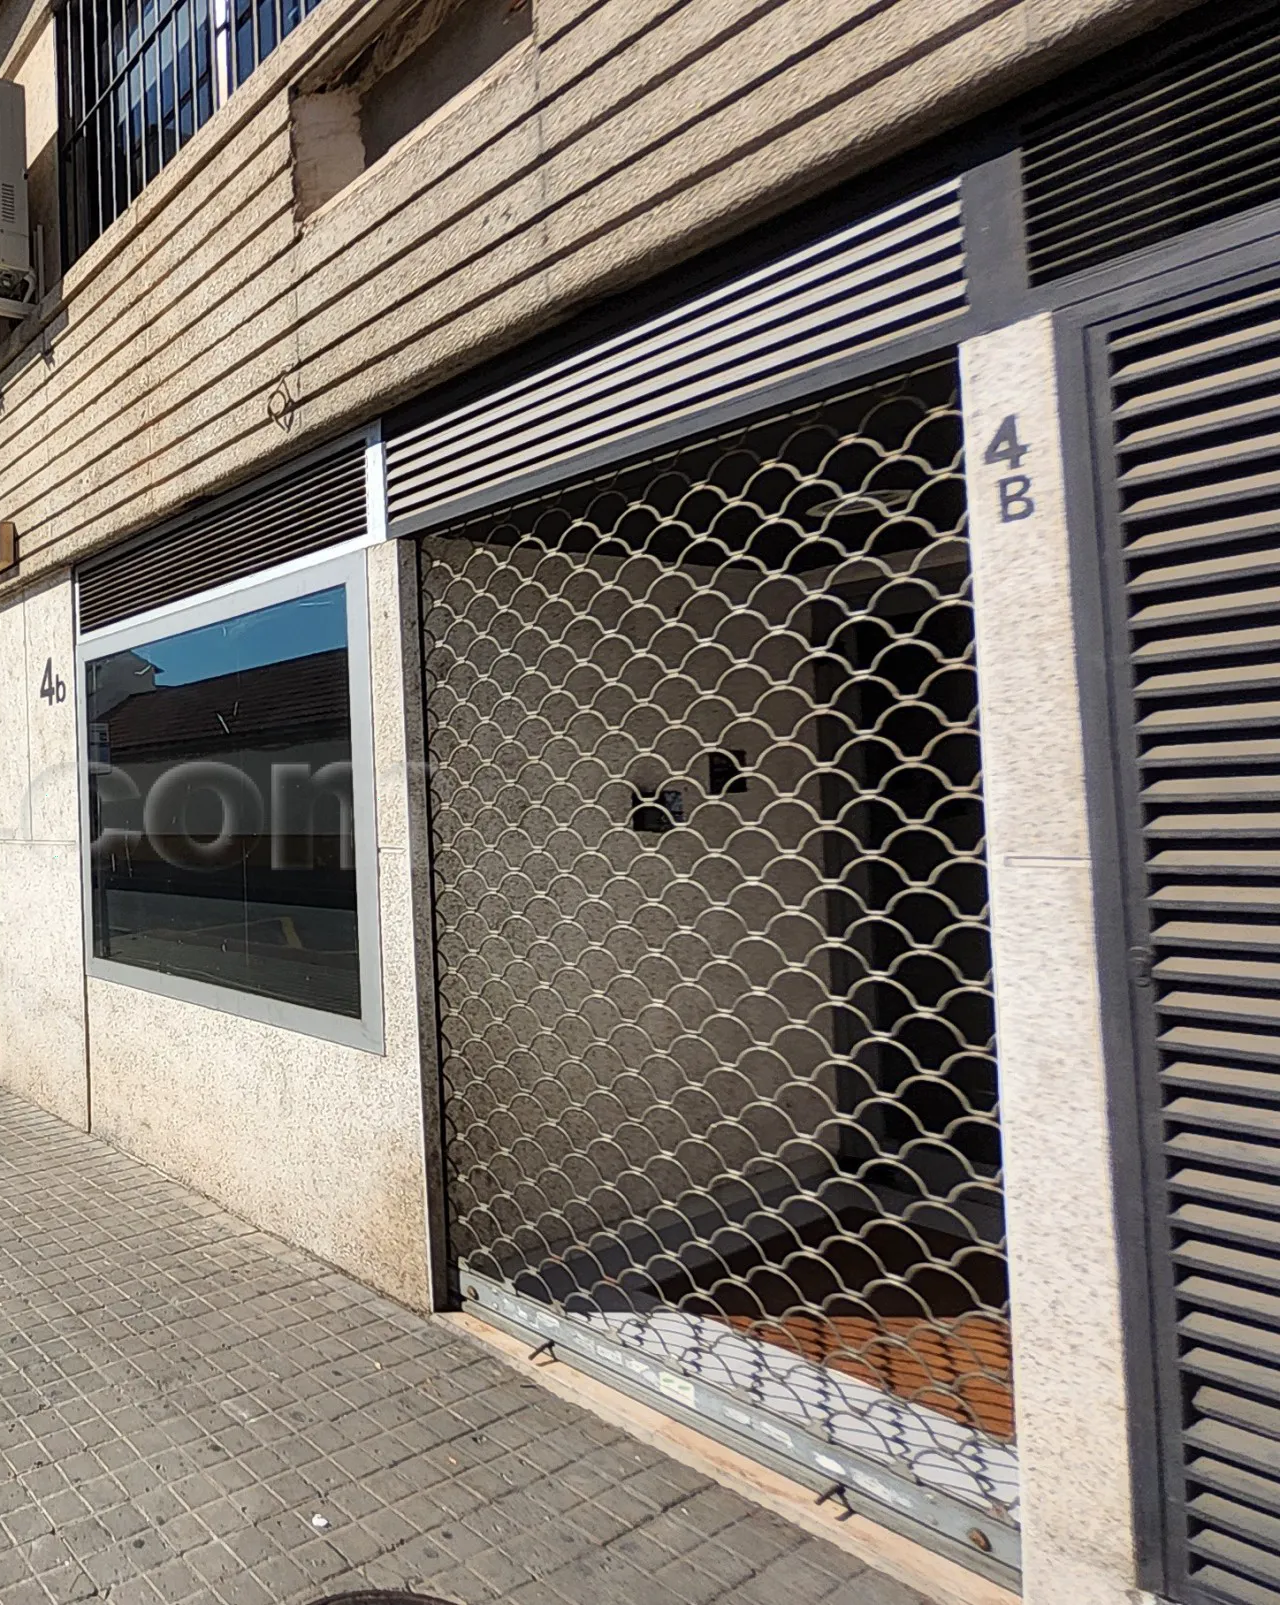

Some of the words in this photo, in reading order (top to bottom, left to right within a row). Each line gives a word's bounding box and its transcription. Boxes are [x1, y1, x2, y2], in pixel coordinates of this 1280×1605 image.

[983, 413, 1031, 470] 4
[999, 475, 1035, 523] B
[40, 656, 66, 706] 4b
